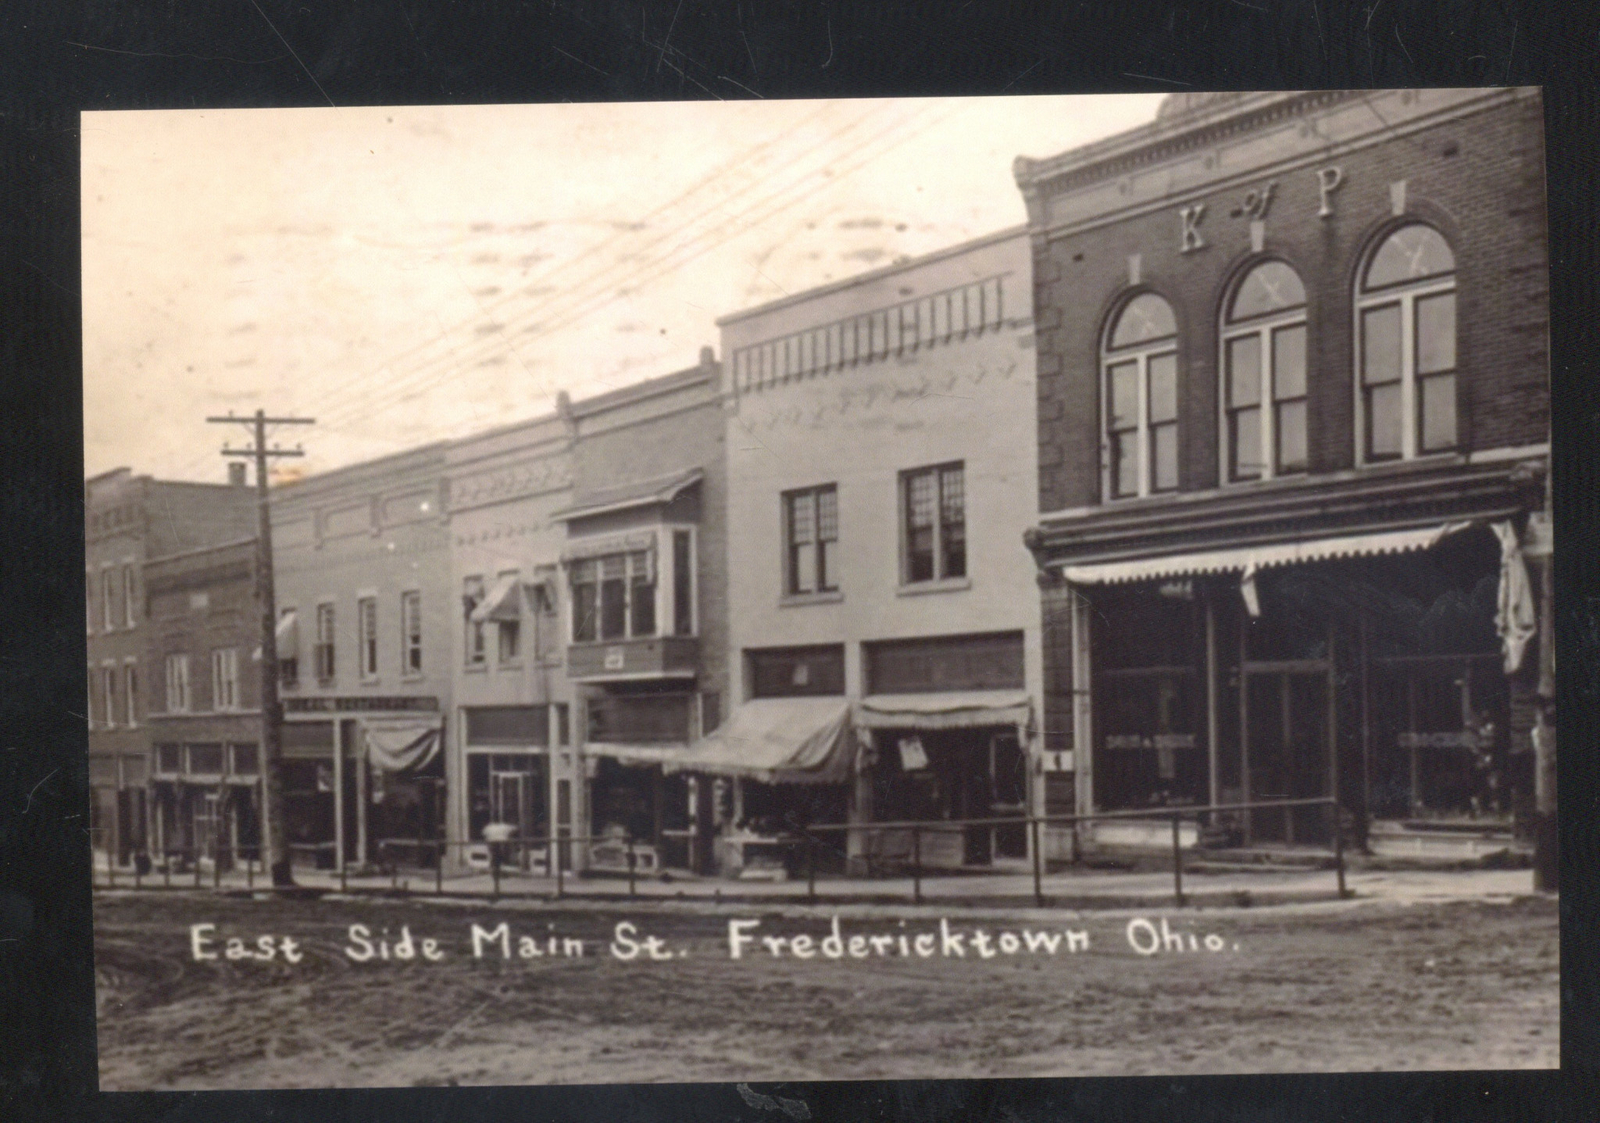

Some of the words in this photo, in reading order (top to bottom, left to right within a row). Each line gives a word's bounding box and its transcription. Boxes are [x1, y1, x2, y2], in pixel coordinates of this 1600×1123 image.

[1179, 204, 1205, 252] K
[1241, 179, 1279, 222] of
[1317, 166, 1342, 217] P
